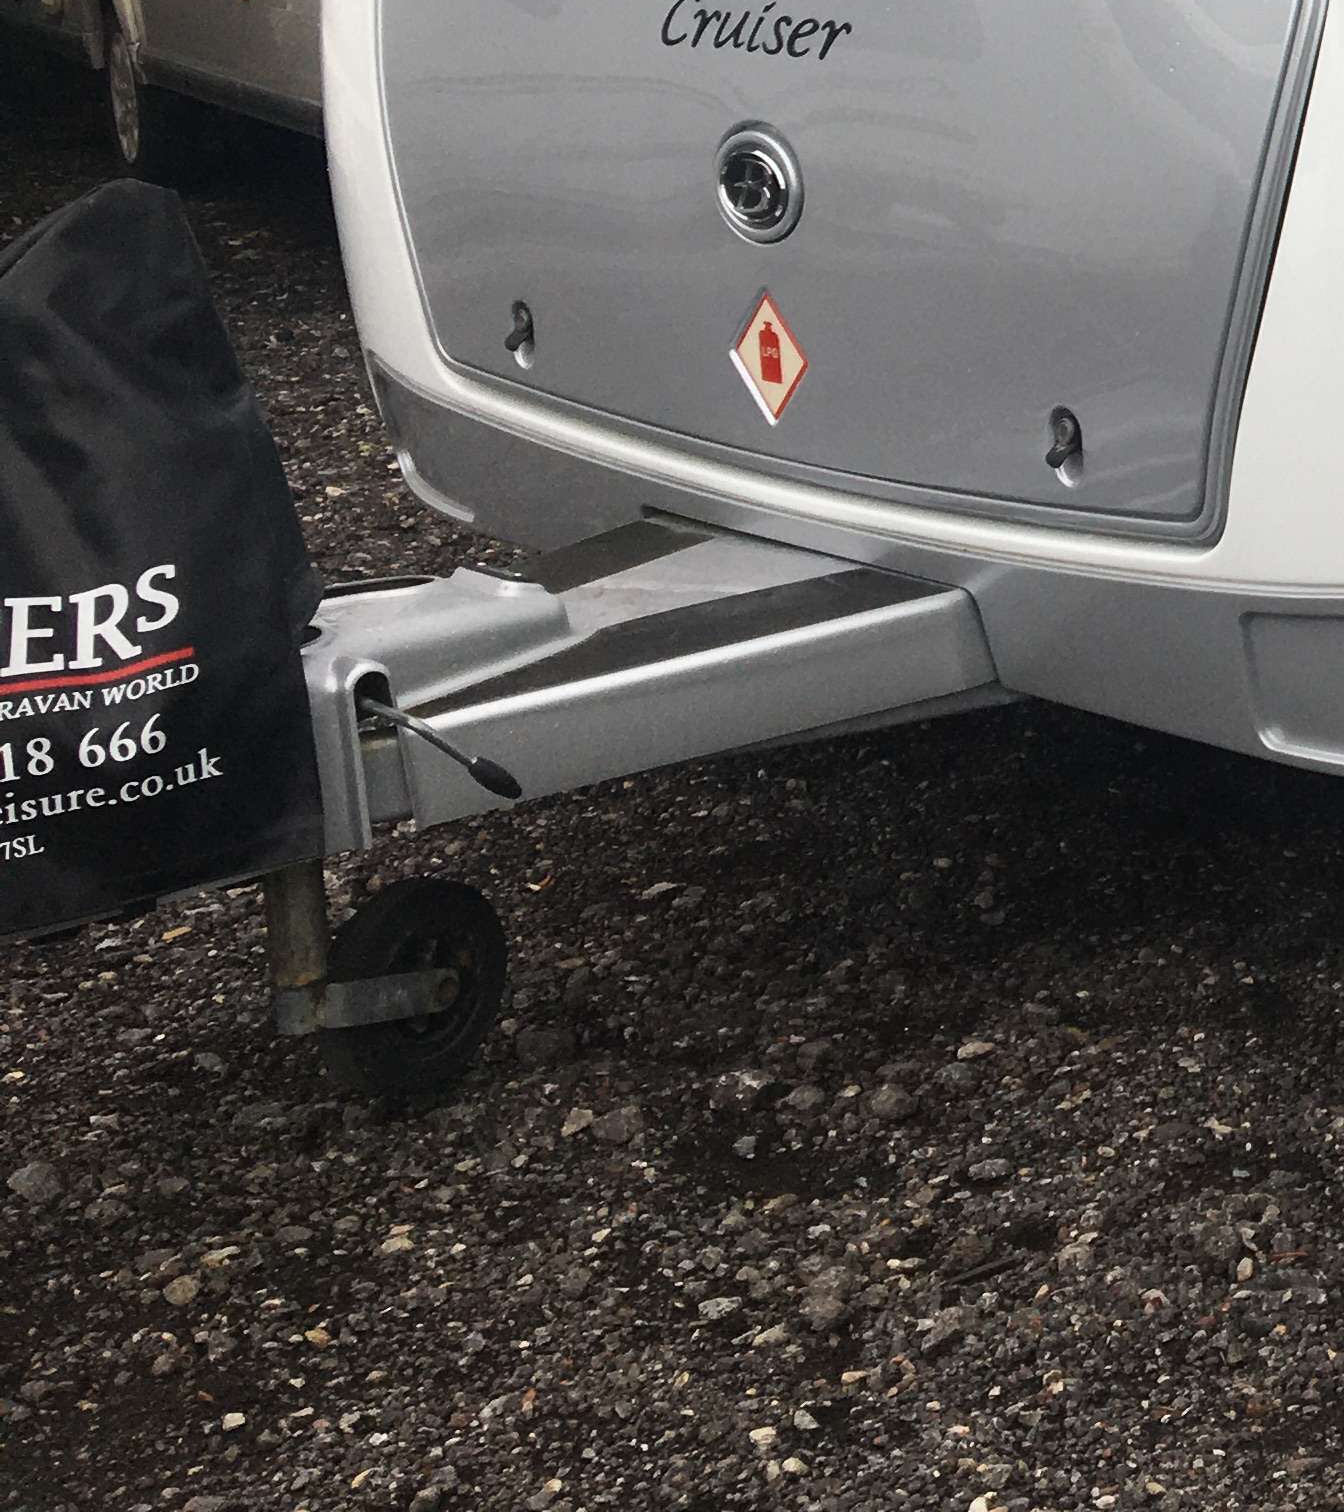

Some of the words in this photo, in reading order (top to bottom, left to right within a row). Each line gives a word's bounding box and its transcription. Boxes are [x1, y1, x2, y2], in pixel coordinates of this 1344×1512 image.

[0, 564, 180, 678] ERS
[102, 663, 200, 707] WORLD
[0, 737, 55, 783] 18
[79, 713, 167, 769] 666
[0, 748, 224, 825] isure.co.uk
